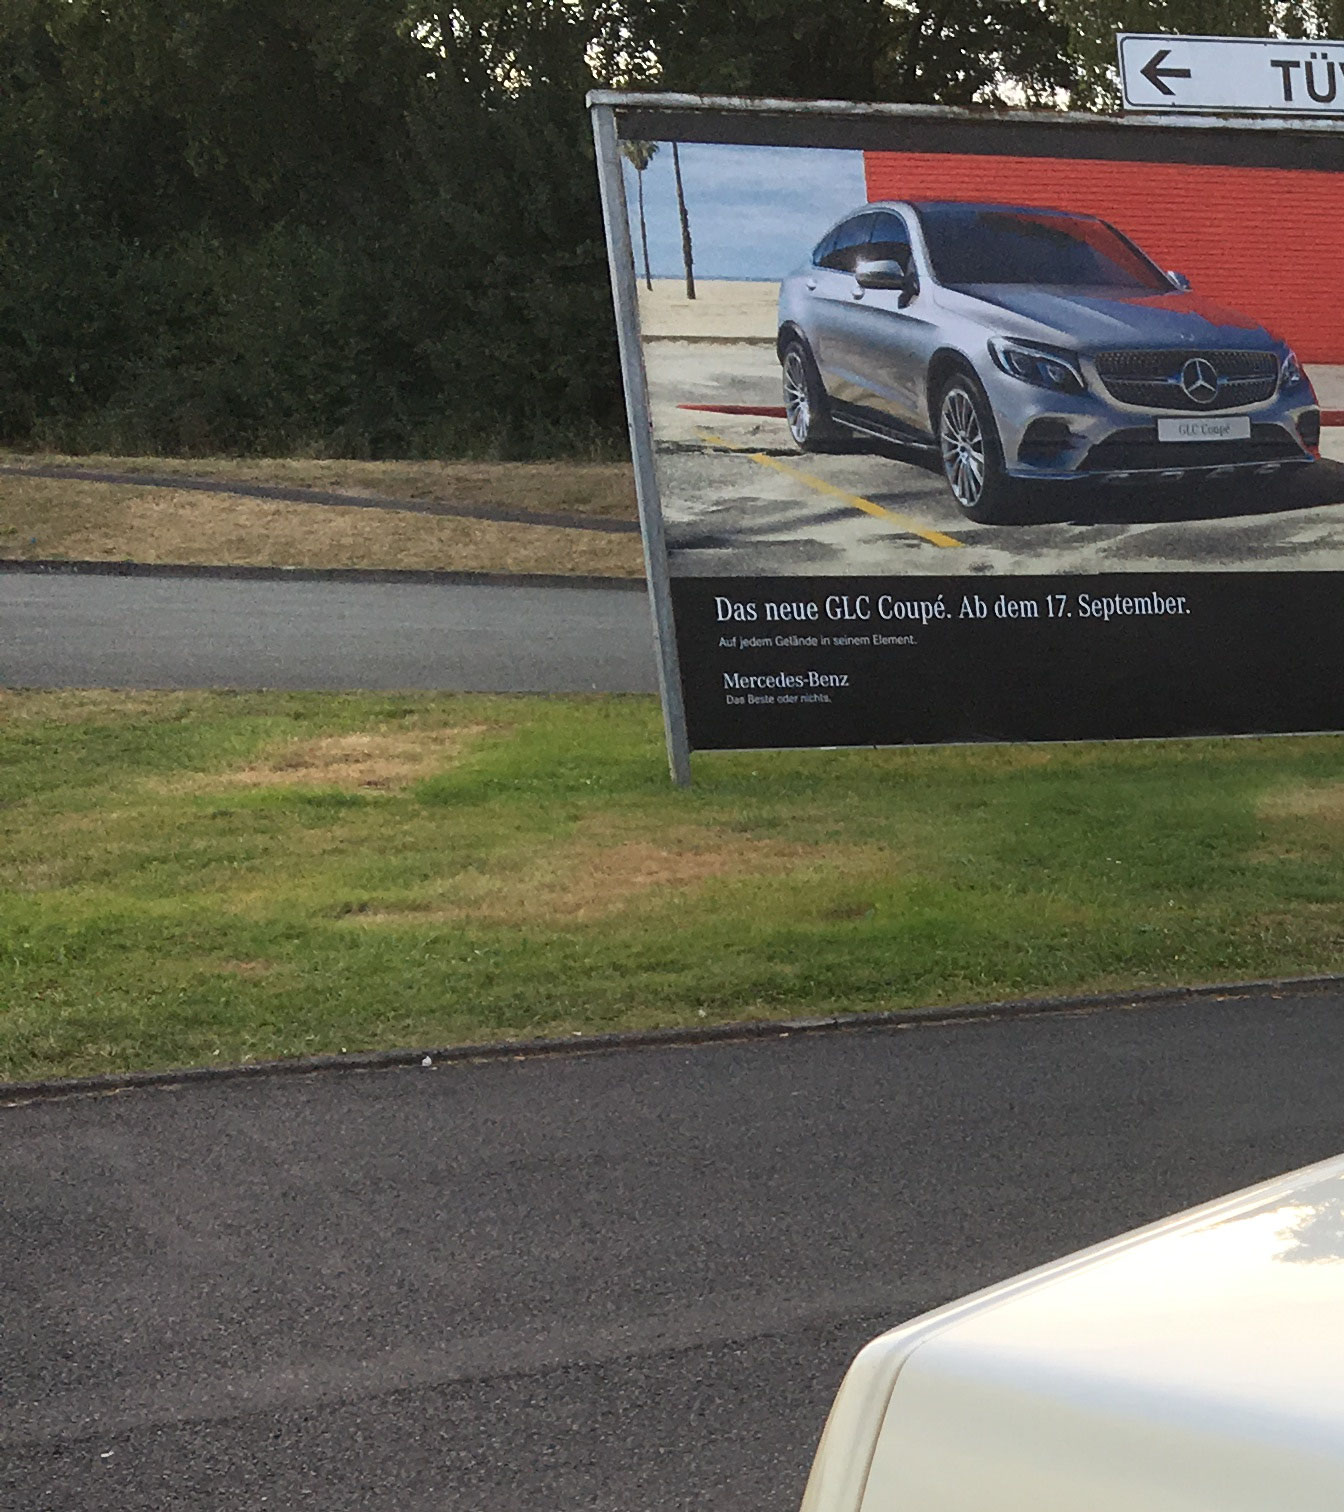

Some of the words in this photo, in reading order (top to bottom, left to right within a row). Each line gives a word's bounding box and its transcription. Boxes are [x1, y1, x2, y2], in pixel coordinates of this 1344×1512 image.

[714, 597, 758, 621] Das
[765, 601, 819, 620] neue
[826, 595, 871, 620] GLC
[878, 594, 951, 624] Coupé.
[959, 595, 988, 618] Ab
[994, 595, 1040, 618] dem
[1047, 594, 1072, 617] 17.
[1078, 592, 1191, 621] September.
[719, 636, 737, 647] Auf
[739, 636, 772, 649] jedem
[775, 635, 818, 647] Gelände
[821, 635, 831, 645] in
[833, 635, 870, 646] seinem
[873, 634, 918, 646] Element.
[723, 671, 850, 688] Mercedes-Benz
[726, 694, 745, 705] Das
[748, 694, 774, 704] Beste
[777, 693, 799, 704] oder
